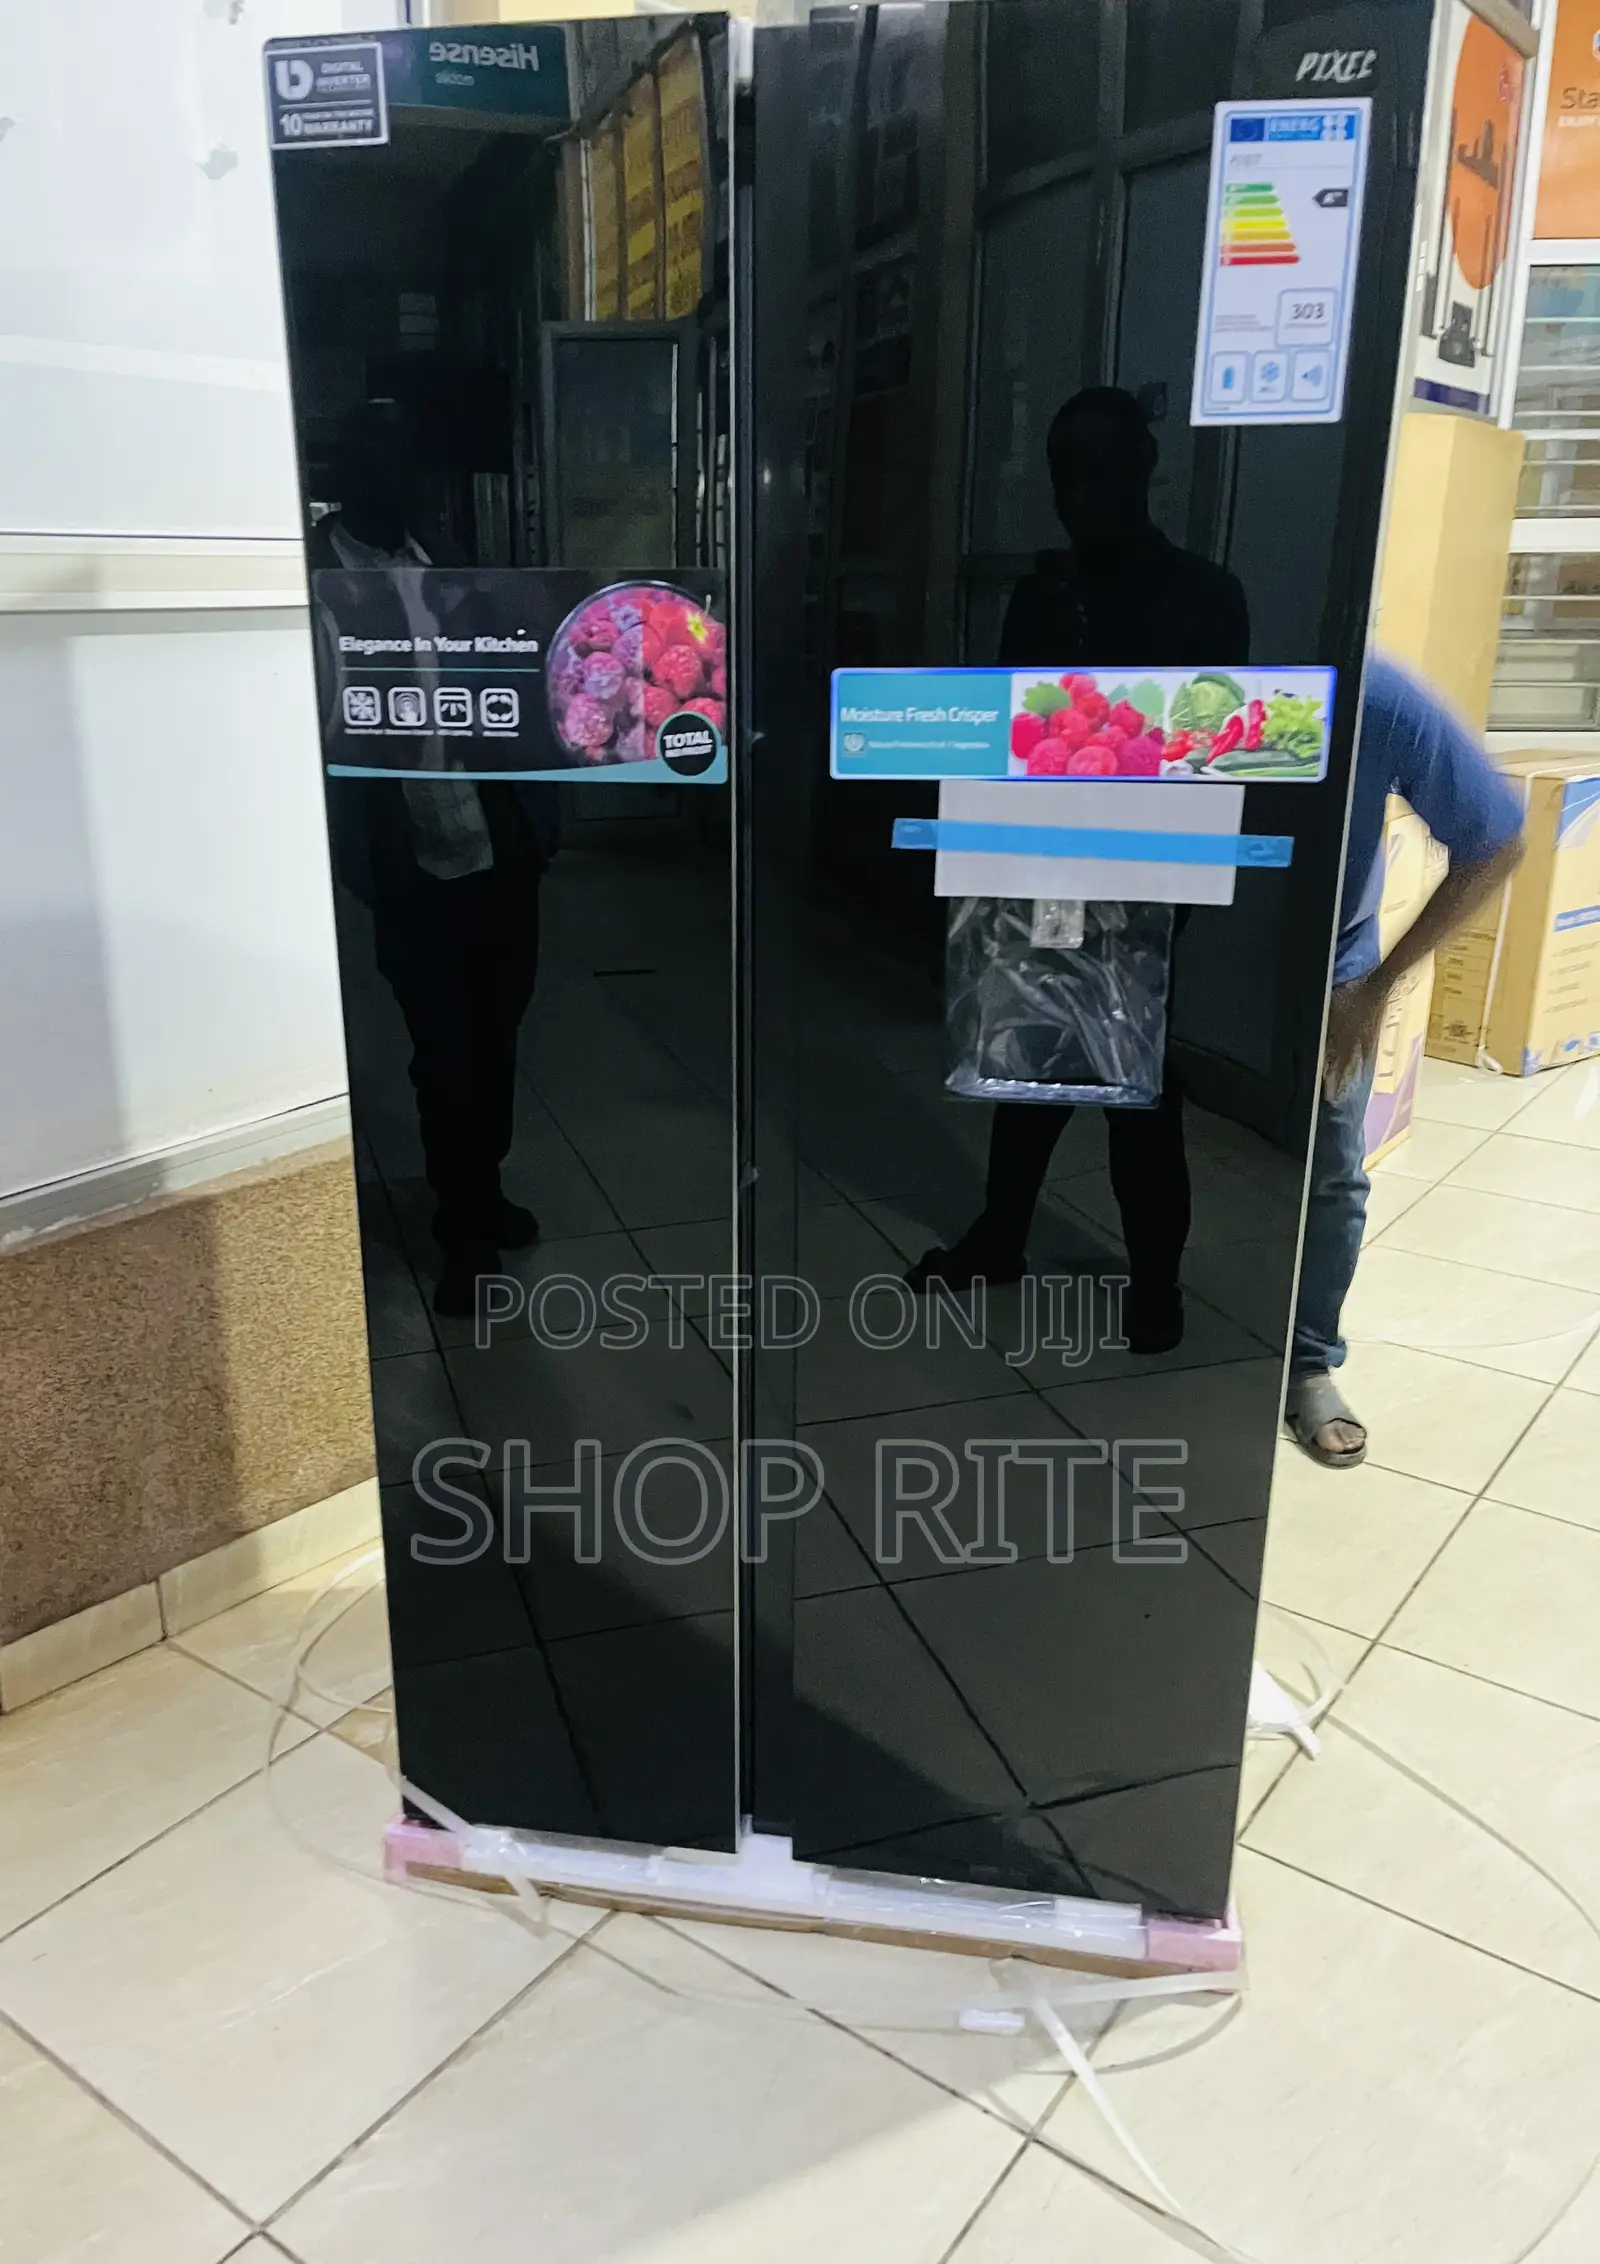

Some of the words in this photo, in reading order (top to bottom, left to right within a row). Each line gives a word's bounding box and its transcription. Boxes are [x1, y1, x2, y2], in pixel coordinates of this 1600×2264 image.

[1295, 49, 1377, 83] PIXEL
[280, 113, 303, 137] 10
[303, 119, 374, 136] WARRANTY
[1291, 302, 1326, 320] 303
[338, 635, 412, 655] Elegance
[433, 636, 473, 653] Your
[474, 636, 539, 653] Kitchen
[840, 707, 903, 722] Moisture
[905, 707, 947, 722] Fresh
[949, 707, 999, 726] Crisper
[663, 730, 713, 749] TOTAL
